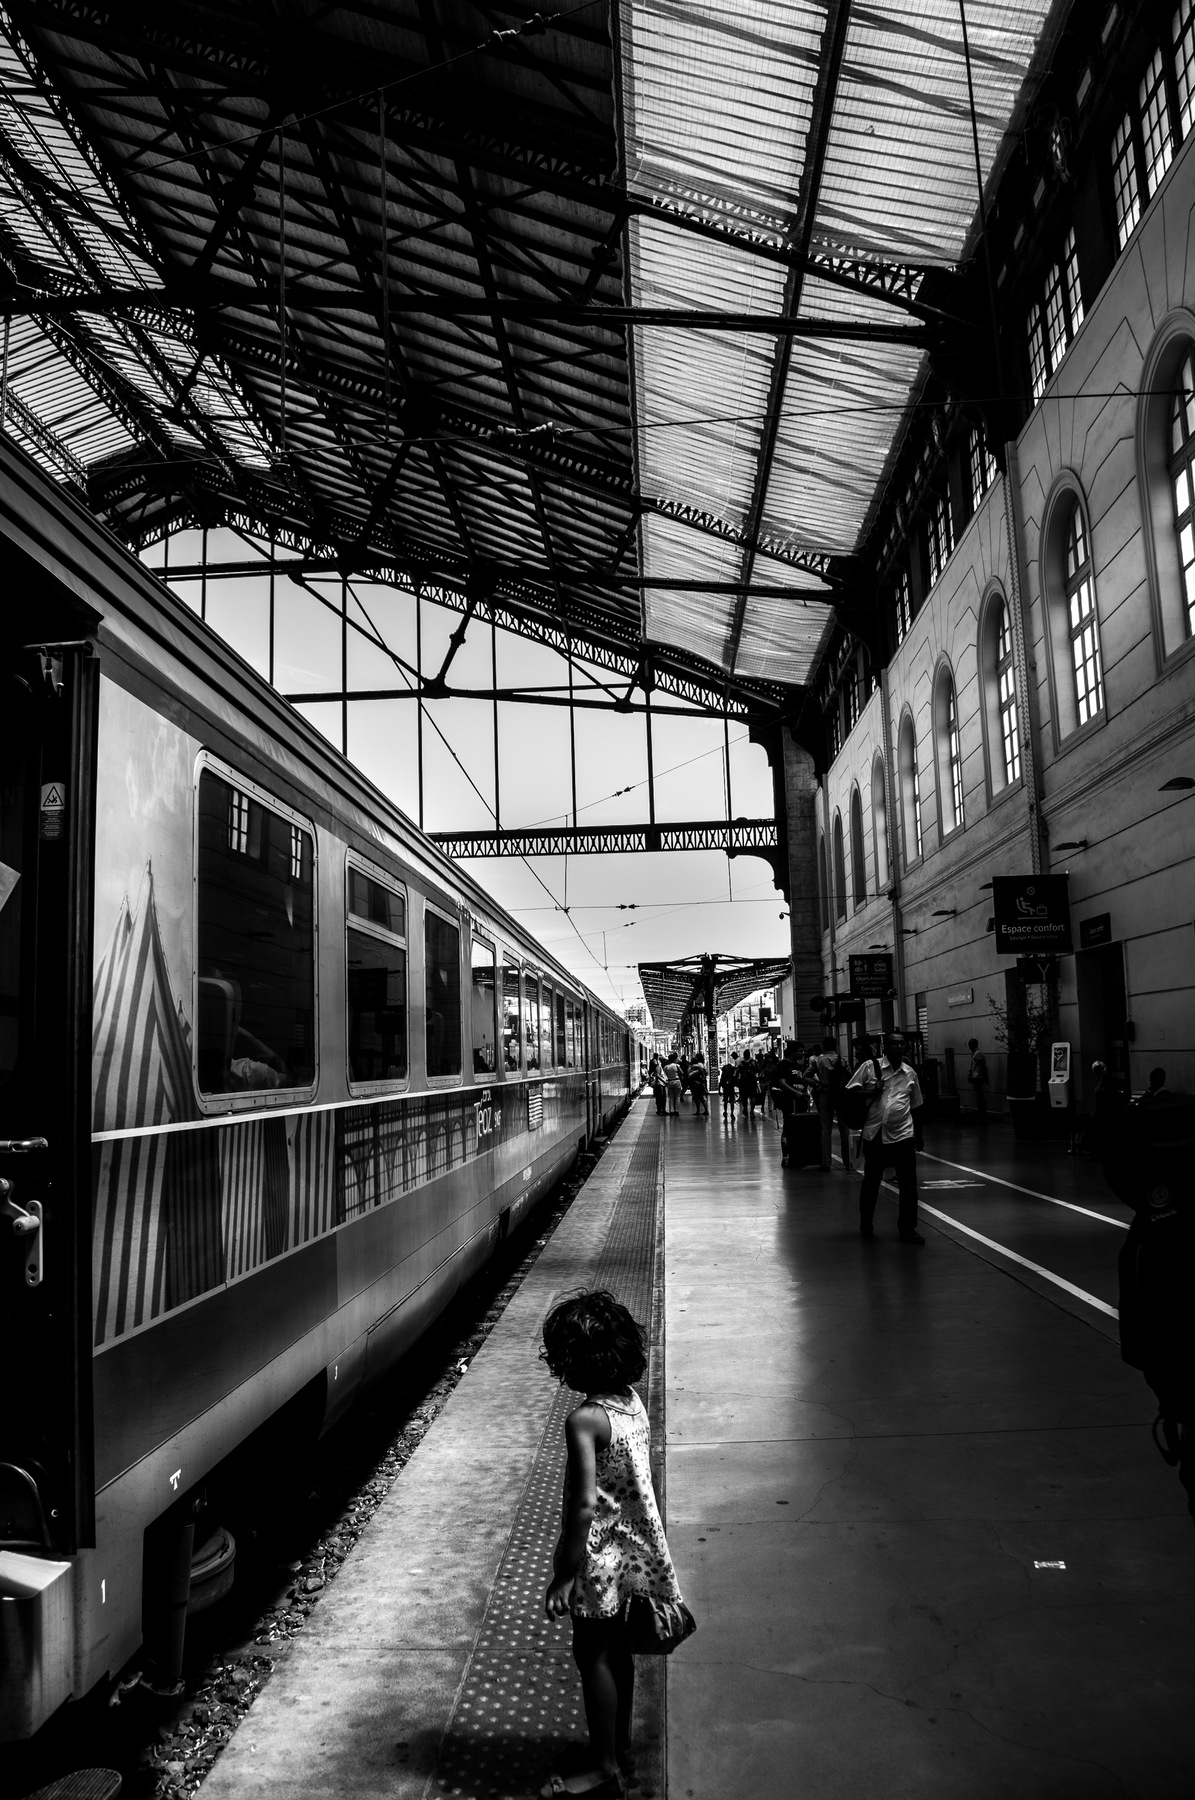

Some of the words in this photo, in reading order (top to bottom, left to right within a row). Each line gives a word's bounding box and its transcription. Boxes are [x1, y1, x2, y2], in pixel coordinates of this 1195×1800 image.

[1001, 924, 1032, 935] Espace
[1033, 922, 1065, 932] confort
[1036, 962, 1050, 982] Y
